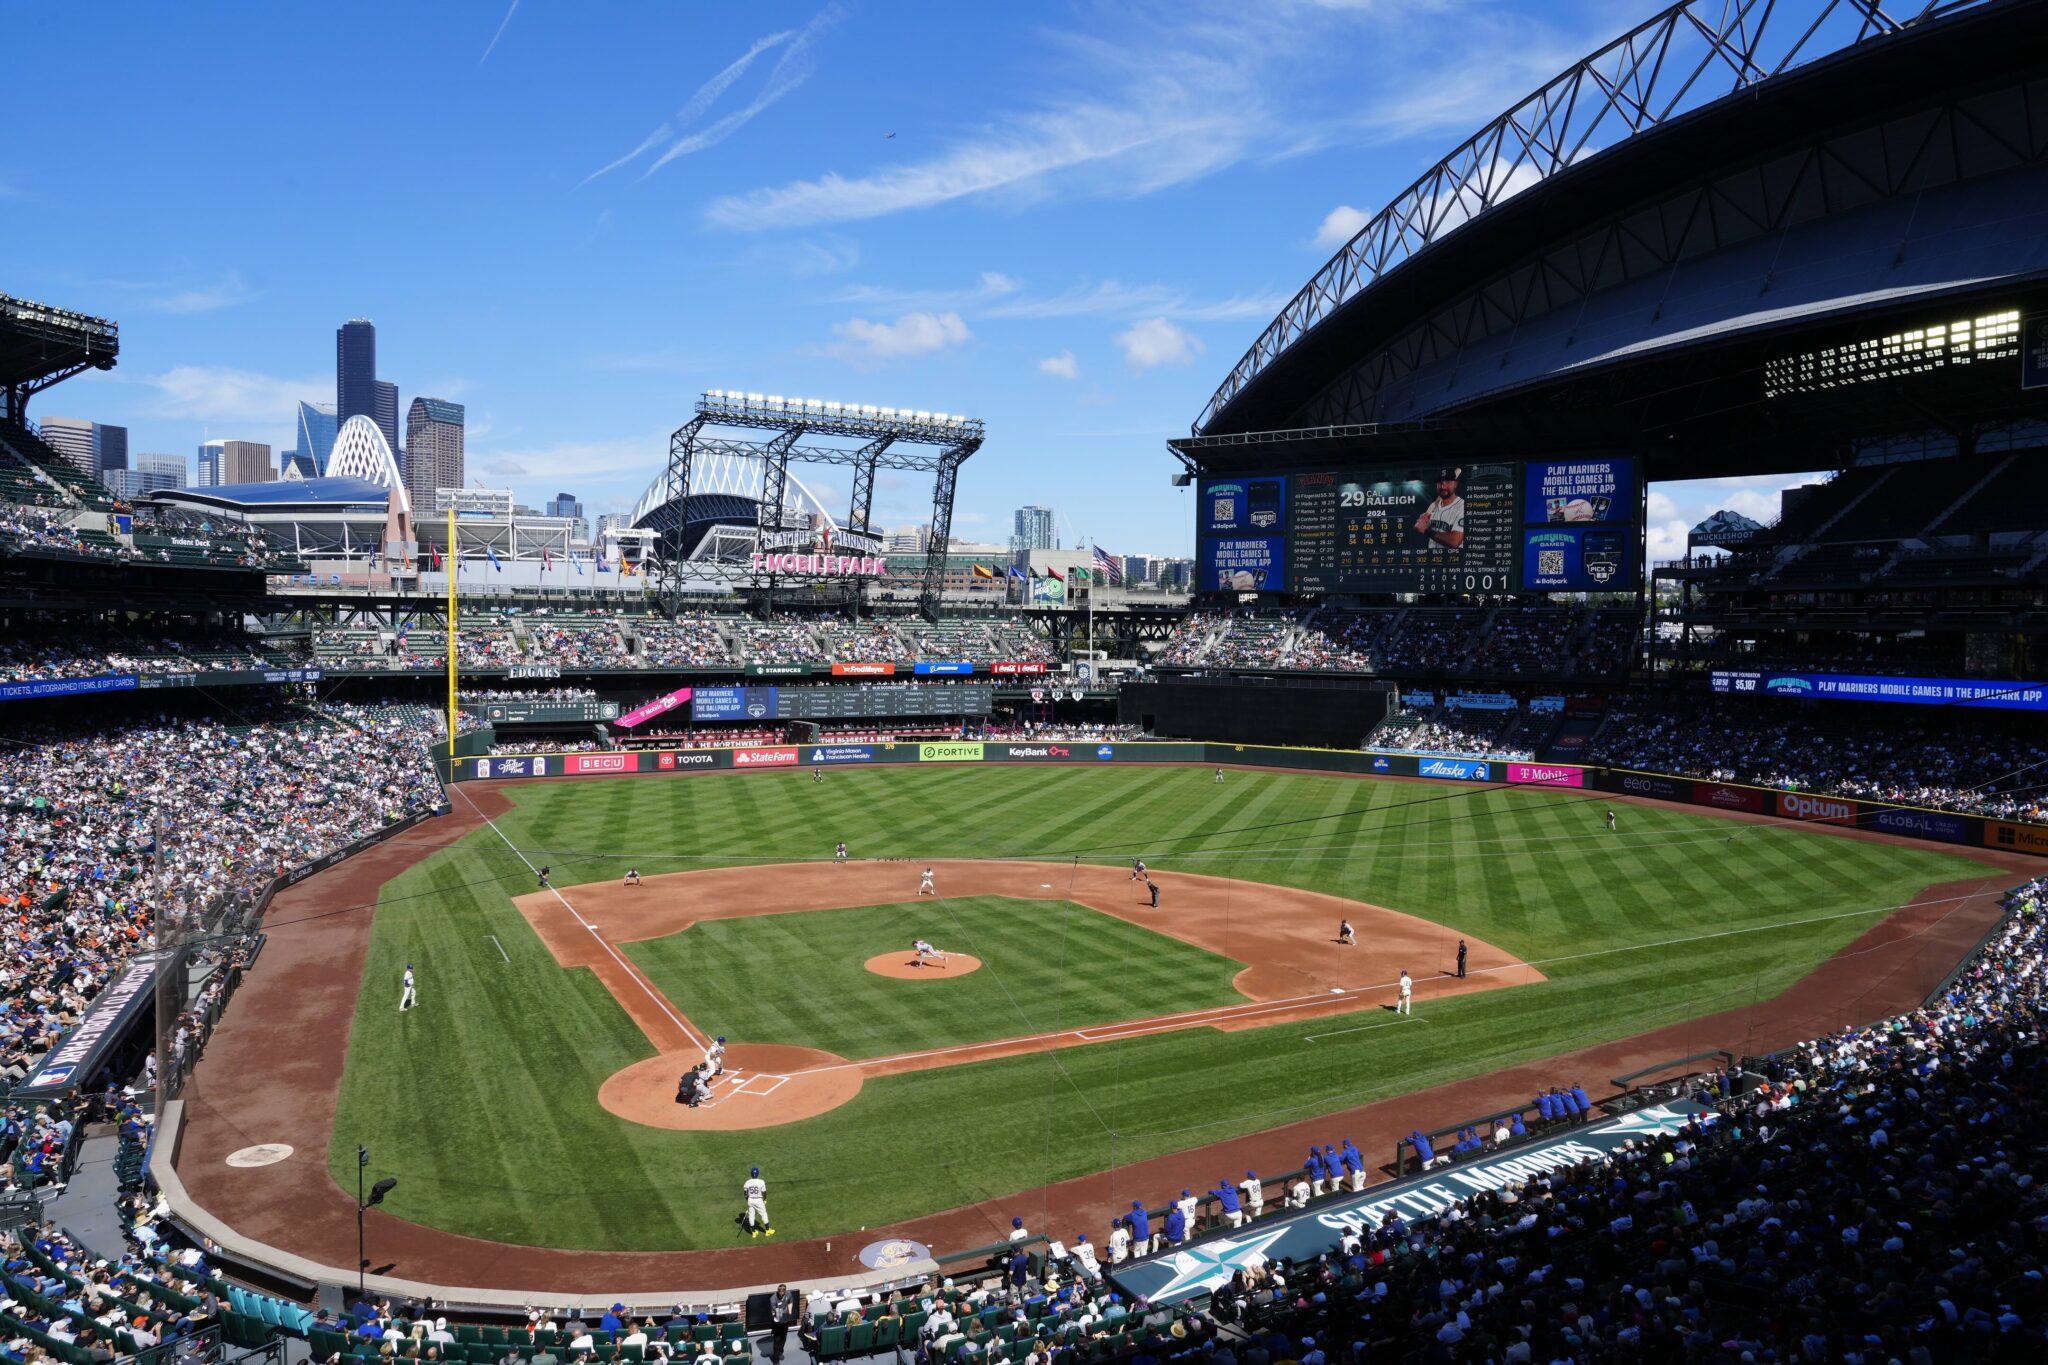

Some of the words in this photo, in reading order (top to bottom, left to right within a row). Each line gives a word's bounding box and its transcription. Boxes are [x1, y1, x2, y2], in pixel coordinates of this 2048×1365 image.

[1547, 466, 1566, 476] PLAY
[1568, 463, 1610, 475] MARINERS
[1543, 475, 1573, 486] MOBILE
[1575, 474, 1603, 485] GAMES
[1605, 473, 1614, 483] IN
[1207, 484, 1244, 496] MARINERS
[1541, 486, 1556, 496] THE
[1558, 484, 1597, 496] BALLPARK
[1599, 483, 1616, 494] APP
[1340, 491, 1364, 507] 29
[1366, 495, 1416, 506] RALEIGH
[1367, 509, 1386, 517] 2024
[171, 537, 194, 546] Trident
[195, 539, 211, 547] Deck
[1528, 533, 1576, 545] MARINERS
[1697, 531, 1754, 542] MUCKLESHOOT
[834, 531, 879, 555] MARINERS
[1219, 541, 1234, 550] PLAY
[1235, 540, 1267, 549] MARINERS
[1216, 550, 1239, 559] MOBILE
[1240, 549, 1262, 558] GAMES
[1262, 549, 1270, 558] IN
[750, 553, 837, 575] T-MOBILE
[839, 556, 887, 577] PARK
[1215, 559, 1226, 568] THE
[1227, 558, 1258, 568] BALLPARK
[1258, 558, 1272, 567] APP
[290, 574, 341, 586] FIELD
[1465, 575, 1475, 590] 0
[1482, 575, 1492, 590] 0
[1500, 575, 1507, 590] 1
[1541, 577, 1568, 585] Ballpark
[3, 686, 32, 696] TICKETS,
[33, 681, 78, 694] AUTOGRAPHED
[97, 680, 102, 689] &
[102, 679, 114, 688] GIFT
[115, 678, 135, 687] CARDS
[1735, 679, 1756, 691] $5,187
[1767, 677, 1812, 690] MARINERS
[695, 690, 708, 698] PLAY
[1818, 681, 1837, 692] PLAY
[1838, 682, 1878, 694] MARINERS
[1880, 684, 1910, 695] MOBILE
[1912, 685, 1942, 697] GAMES
[1944, 687, 1953, 698] IN
[1956, 687, 1972, 698] THE
[1974, 688, 2020, 701] BALLPARK
[2023, 690, 2042, 702] APP
[660, 696, 678, 709] Pen
[695, 697, 714, 705] MOBILE
[706, 704, 731, 712] BALLPARK
[937, 746, 979, 756] FORTIVE
[1009, 747, 1048, 758] KeyBank
[583, 758, 621, 768] BECU
[677, 755, 713, 764] TOYOTA
[1422, 761, 1467, 776] Alaska
[1520, 768, 1529, 779] T
[1532, 769, 1569, 782] Mobile
[1623, 777, 1652, 792] eero
[1783, 794, 1849, 819] Optum
[1879, 813, 1933, 832] GLOBAL
[1449, 1139, 1606, 1192] MARINERS
[1251, 1184, 1261, 1193] 80
[1300, 1188, 1310, 1197] 76
[1318, 1182, 1468, 1238] SEATTLE
[1120, 1237, 1126, 1246] 2
[1083, 1249, 1093, 1260] 39
